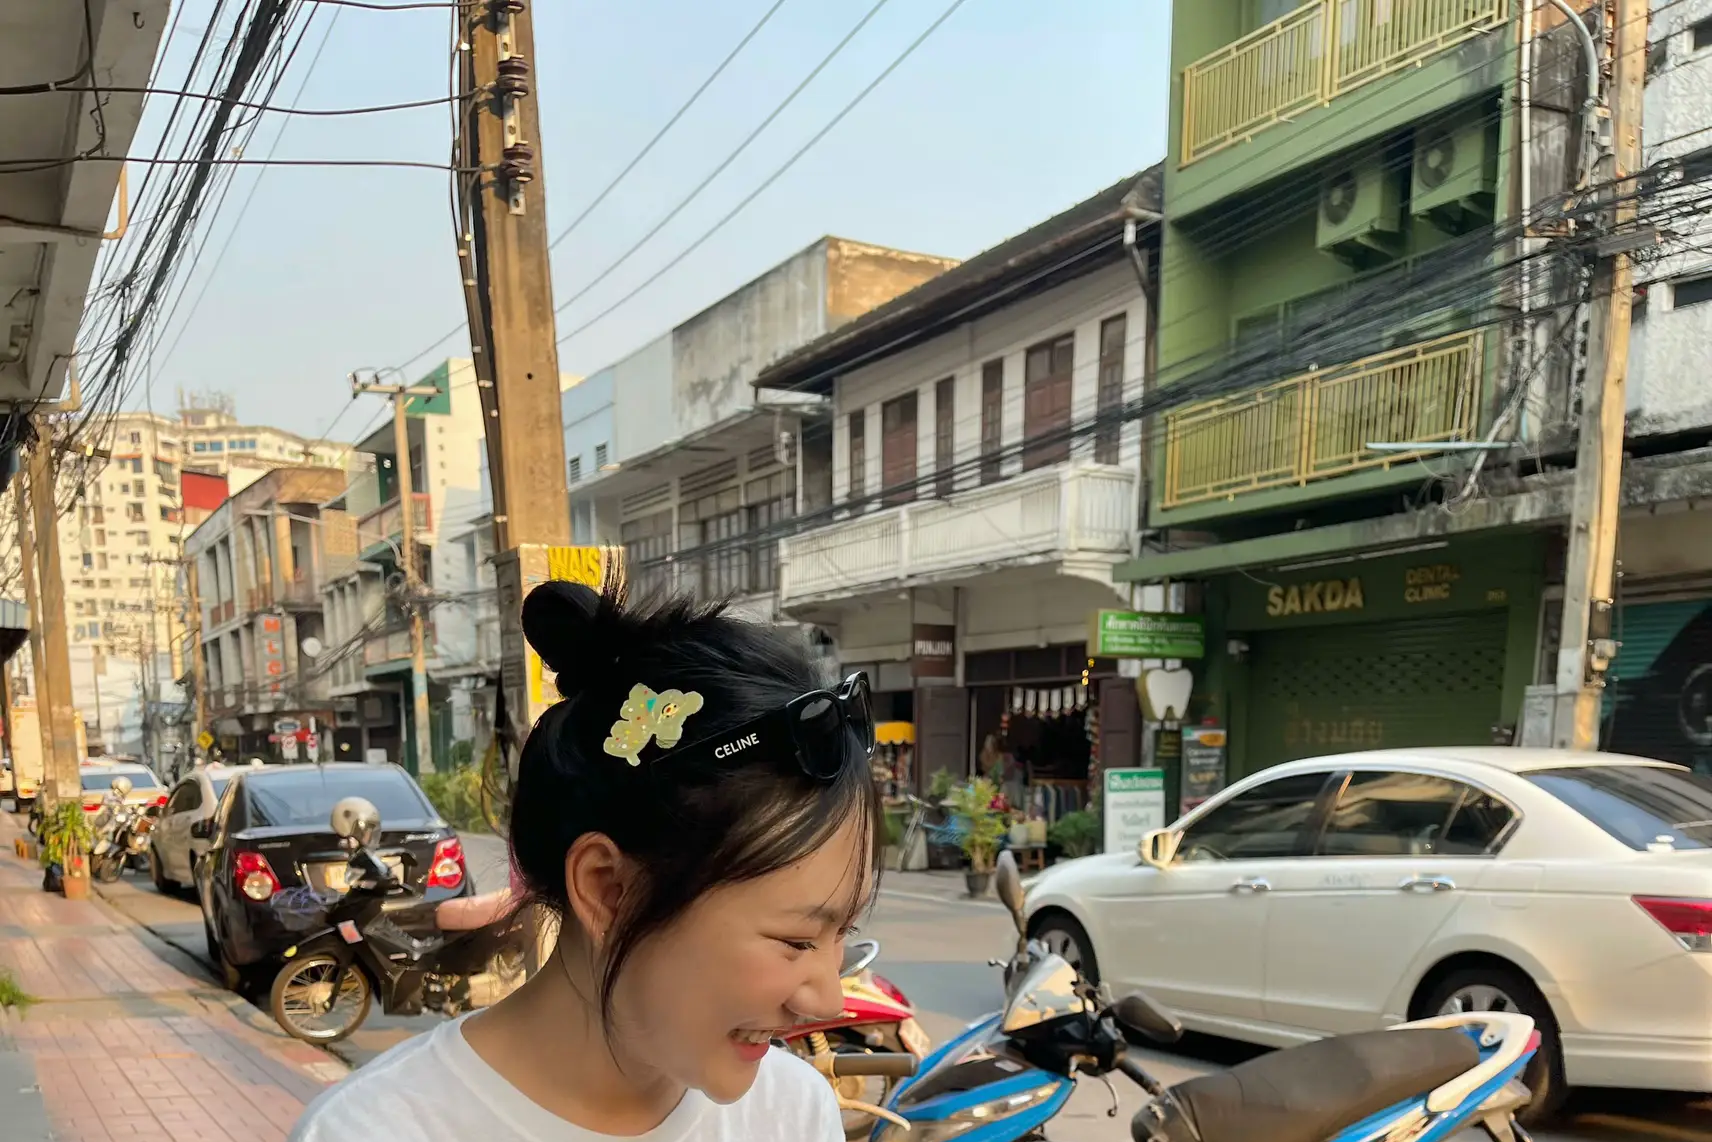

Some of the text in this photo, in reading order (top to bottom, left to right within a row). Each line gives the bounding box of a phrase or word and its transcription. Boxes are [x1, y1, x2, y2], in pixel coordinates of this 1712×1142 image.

[1266, 577, 1364, 617] SAKDA
[1404, 583, 1451, 603] CLINIC
[714, 732, 760, 759] CELINE
